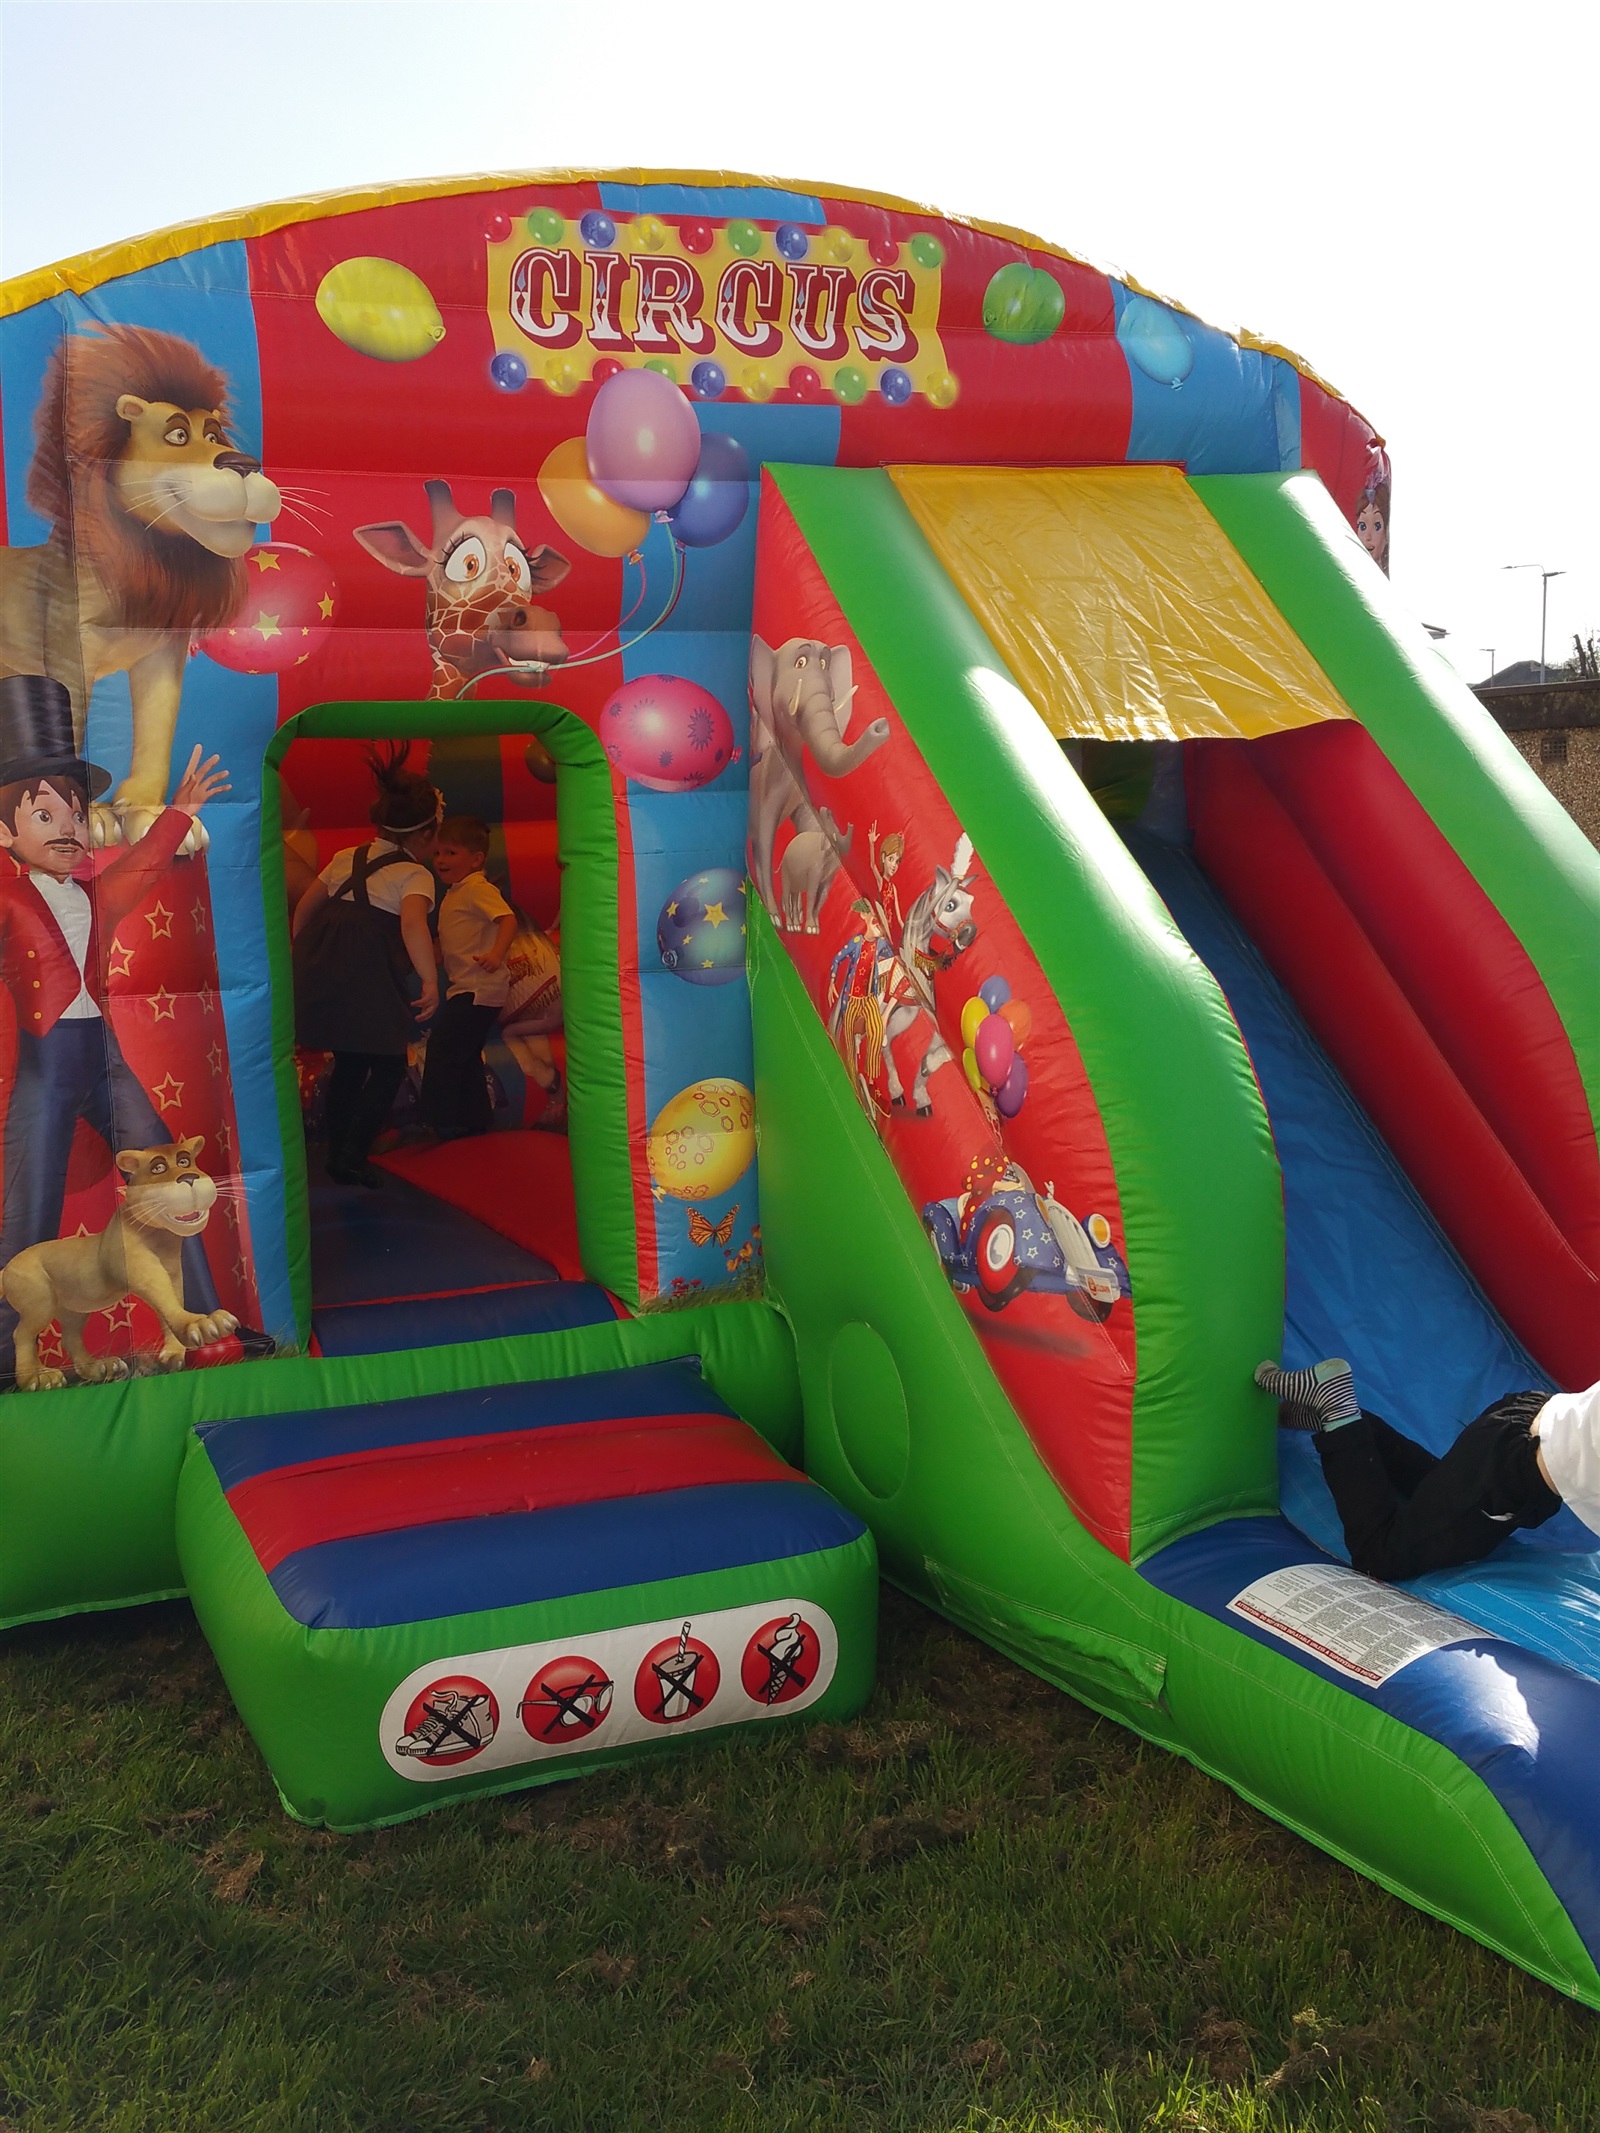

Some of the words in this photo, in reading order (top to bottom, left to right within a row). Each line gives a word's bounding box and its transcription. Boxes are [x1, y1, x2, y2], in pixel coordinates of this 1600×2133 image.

[510, 248, 919, 363] CIRCUS
[1273, 1622, 1287, 1632] ENTER
[1286, 1628, 1310, 1643] INFLATABLE
[1329, 1651, 1356, 1670] SUPERVISOR
